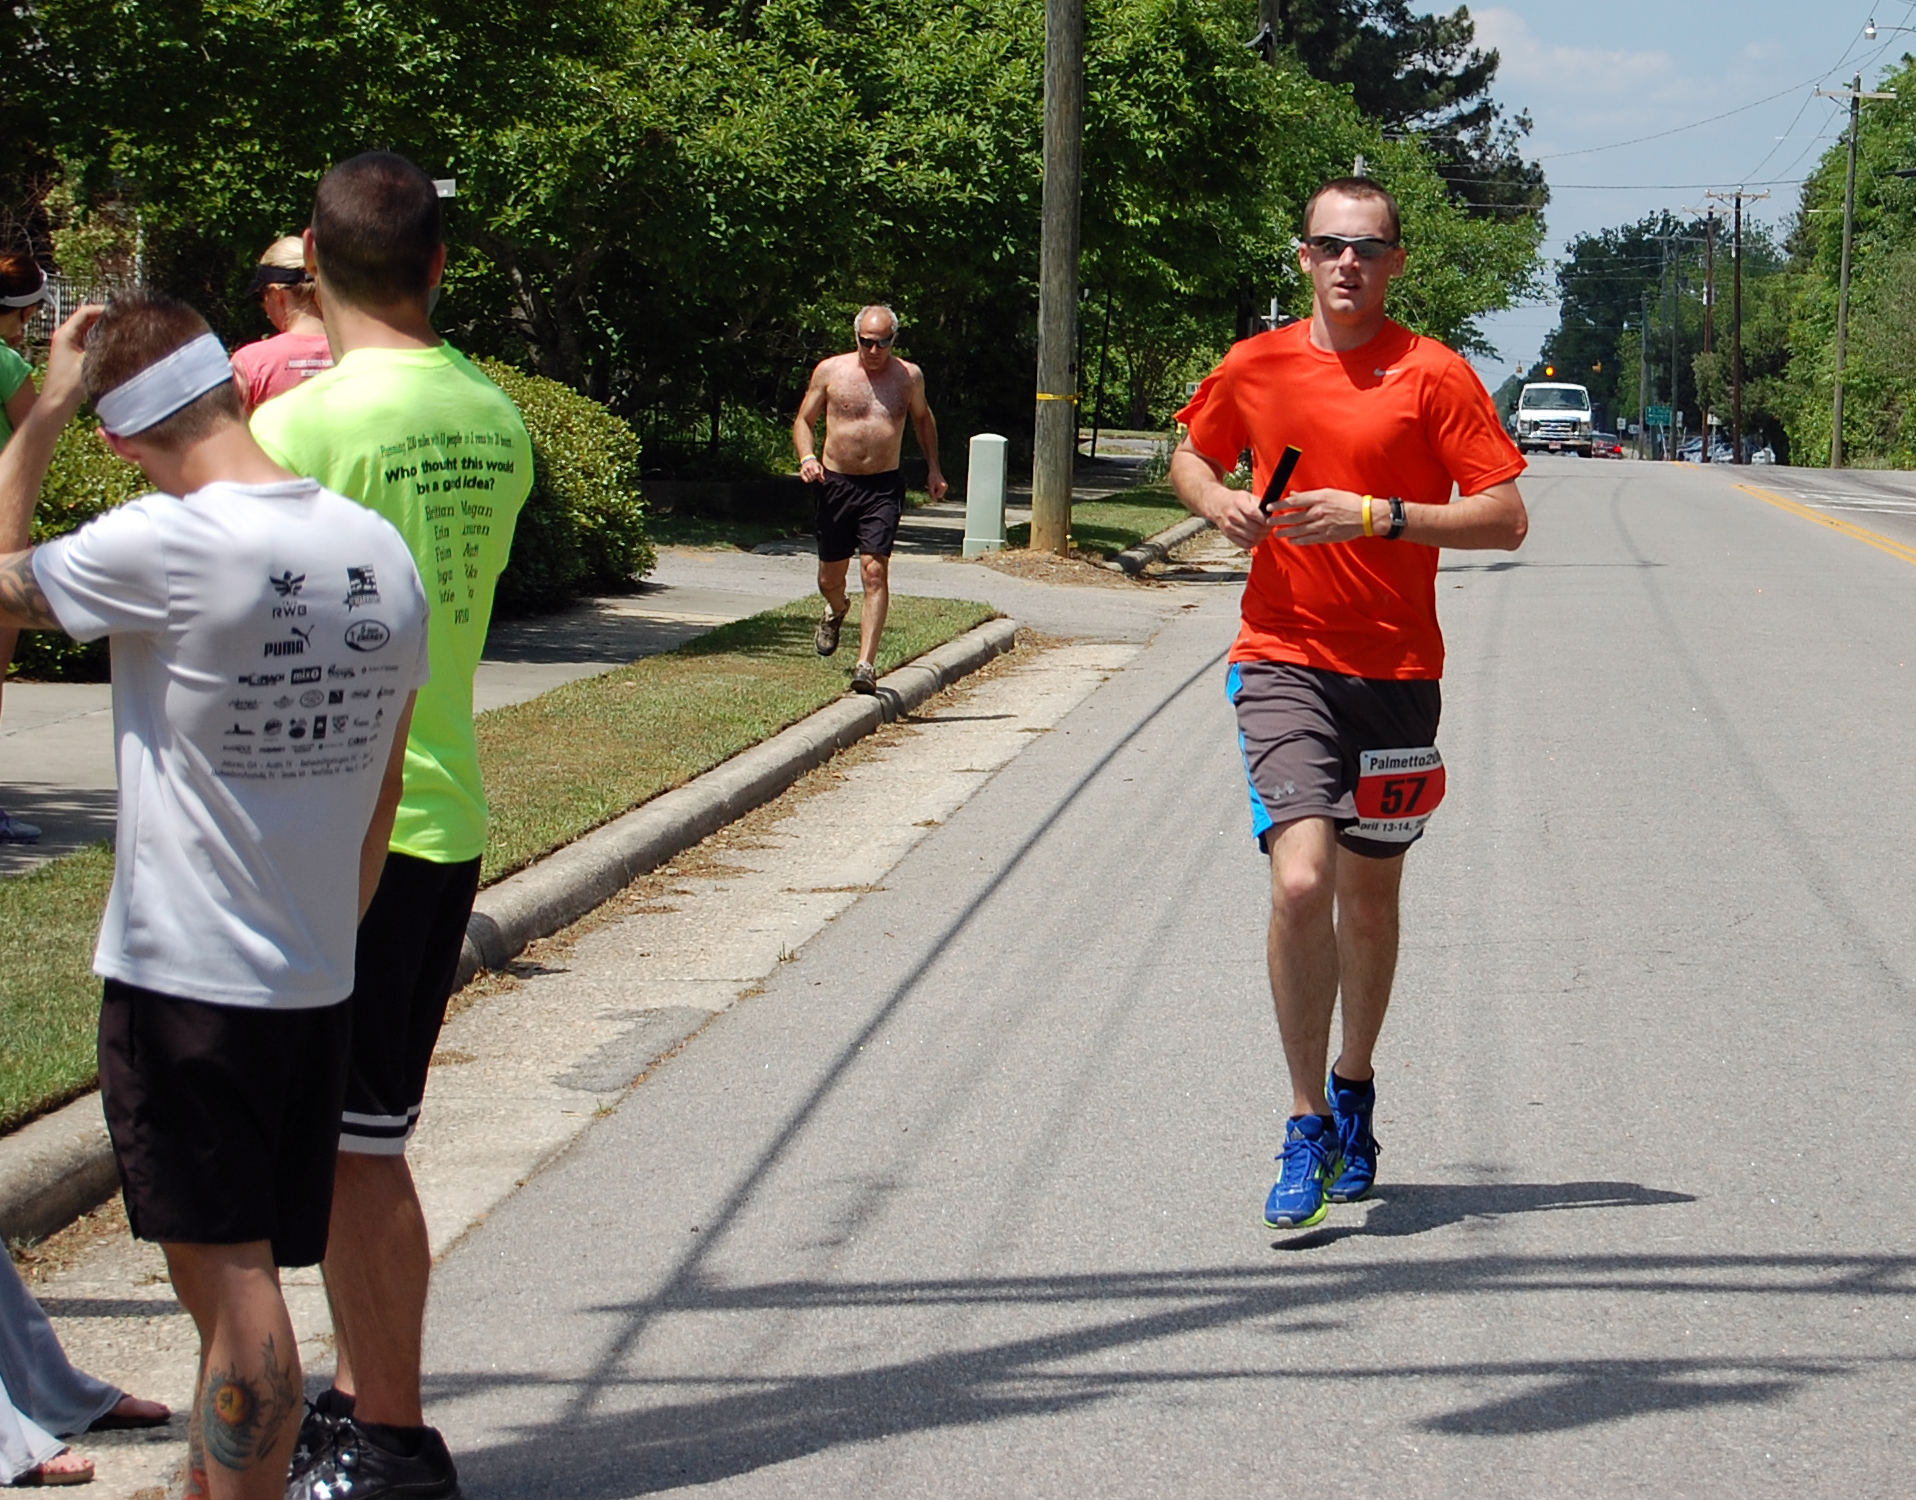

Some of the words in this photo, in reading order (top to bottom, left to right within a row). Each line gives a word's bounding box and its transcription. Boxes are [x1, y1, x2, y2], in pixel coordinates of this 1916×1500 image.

[384, 465, 418, 484] Who
[420, 456, 458, 474] thouht
[460, 456, 484, 471] this
[486, 460, 515, 474] would
[432, 481, 440, 492] a
[463, 475, 496, 491] idea?
[263, 640, 304, 658] PUMA
[1380, 775, 1429, 815] 57
[1360, 821, 1379, 831] pril
